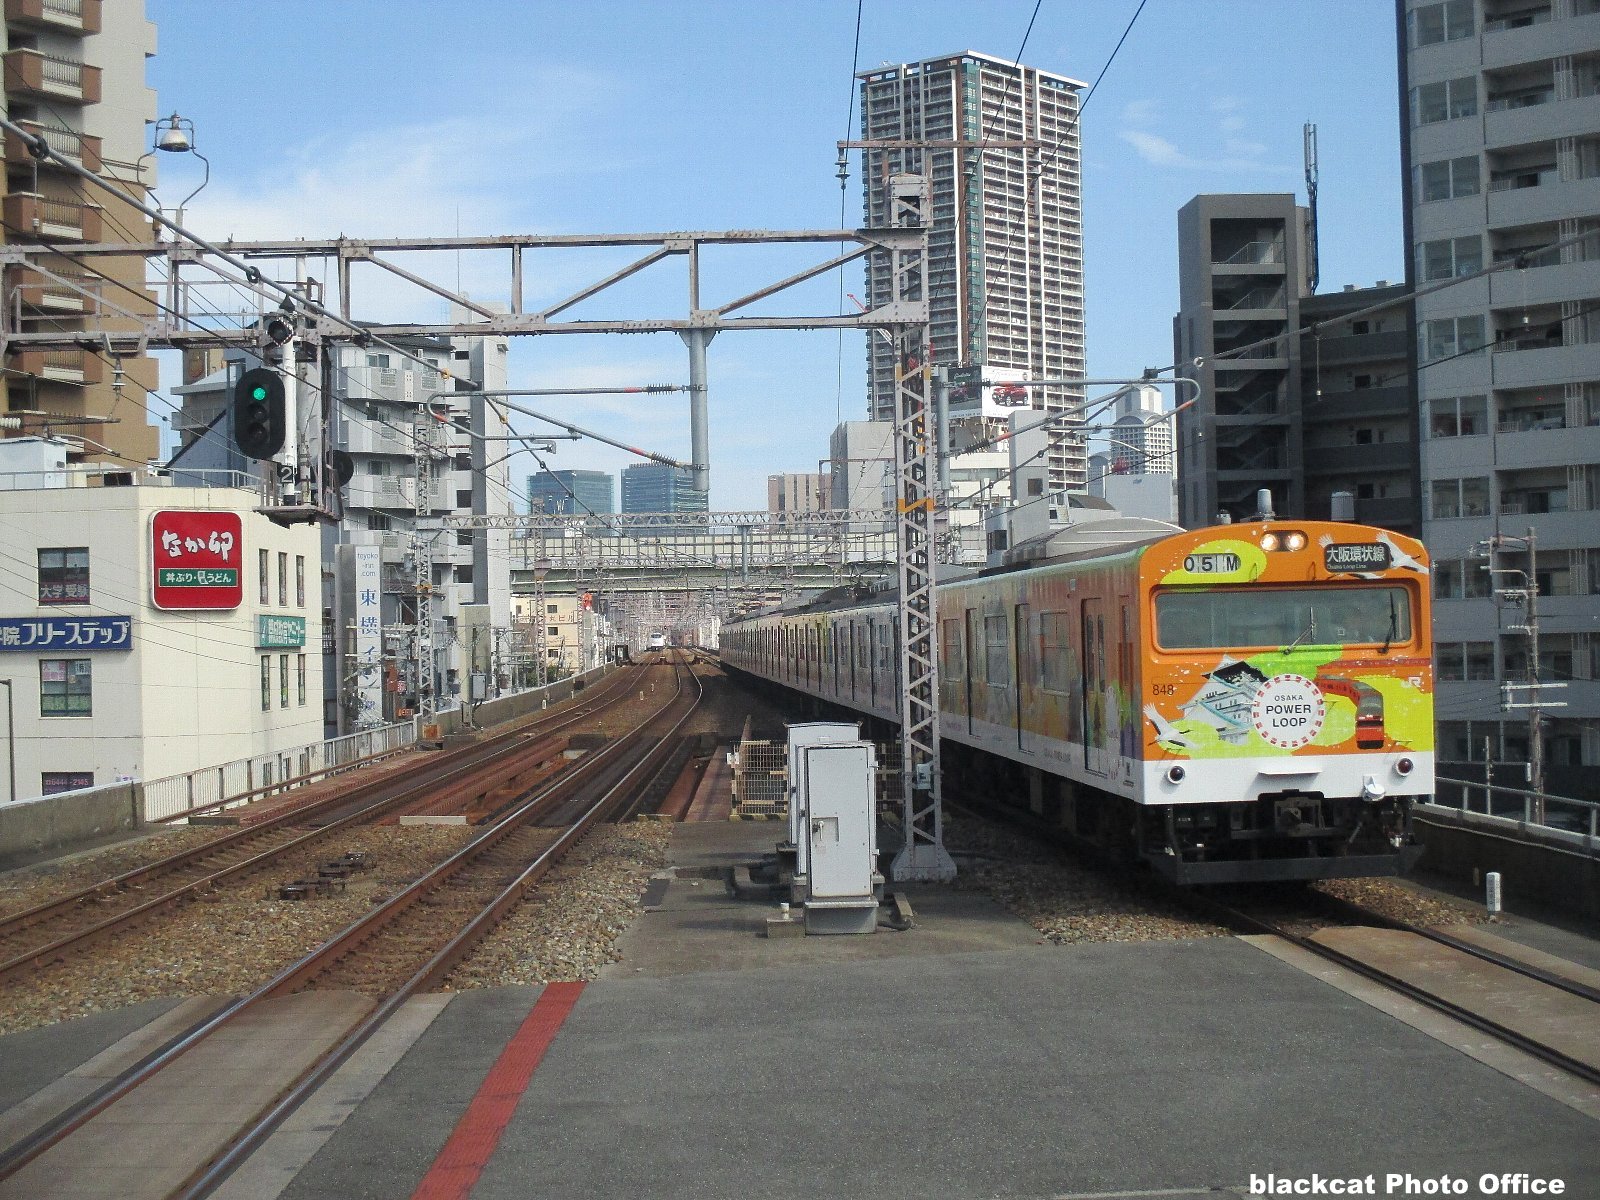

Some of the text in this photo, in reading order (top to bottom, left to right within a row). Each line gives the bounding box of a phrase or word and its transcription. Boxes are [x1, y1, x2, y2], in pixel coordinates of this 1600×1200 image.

[281, 466, 293, 482] 2
[162, 529, 234, 563] なか卯
[1327, 545, 1385, 562] 大阪環状線
[40, 584, 89, 598] 大学受験
[0, 621, 131, 646] 院フリーステップ
[1152, 684, 1174, 696] 848
[1274, 694, 1304, 702] OSAKA
[1266, 704, 1312, 715] POWER
[1272, 717, 1307, 728] LOOP
